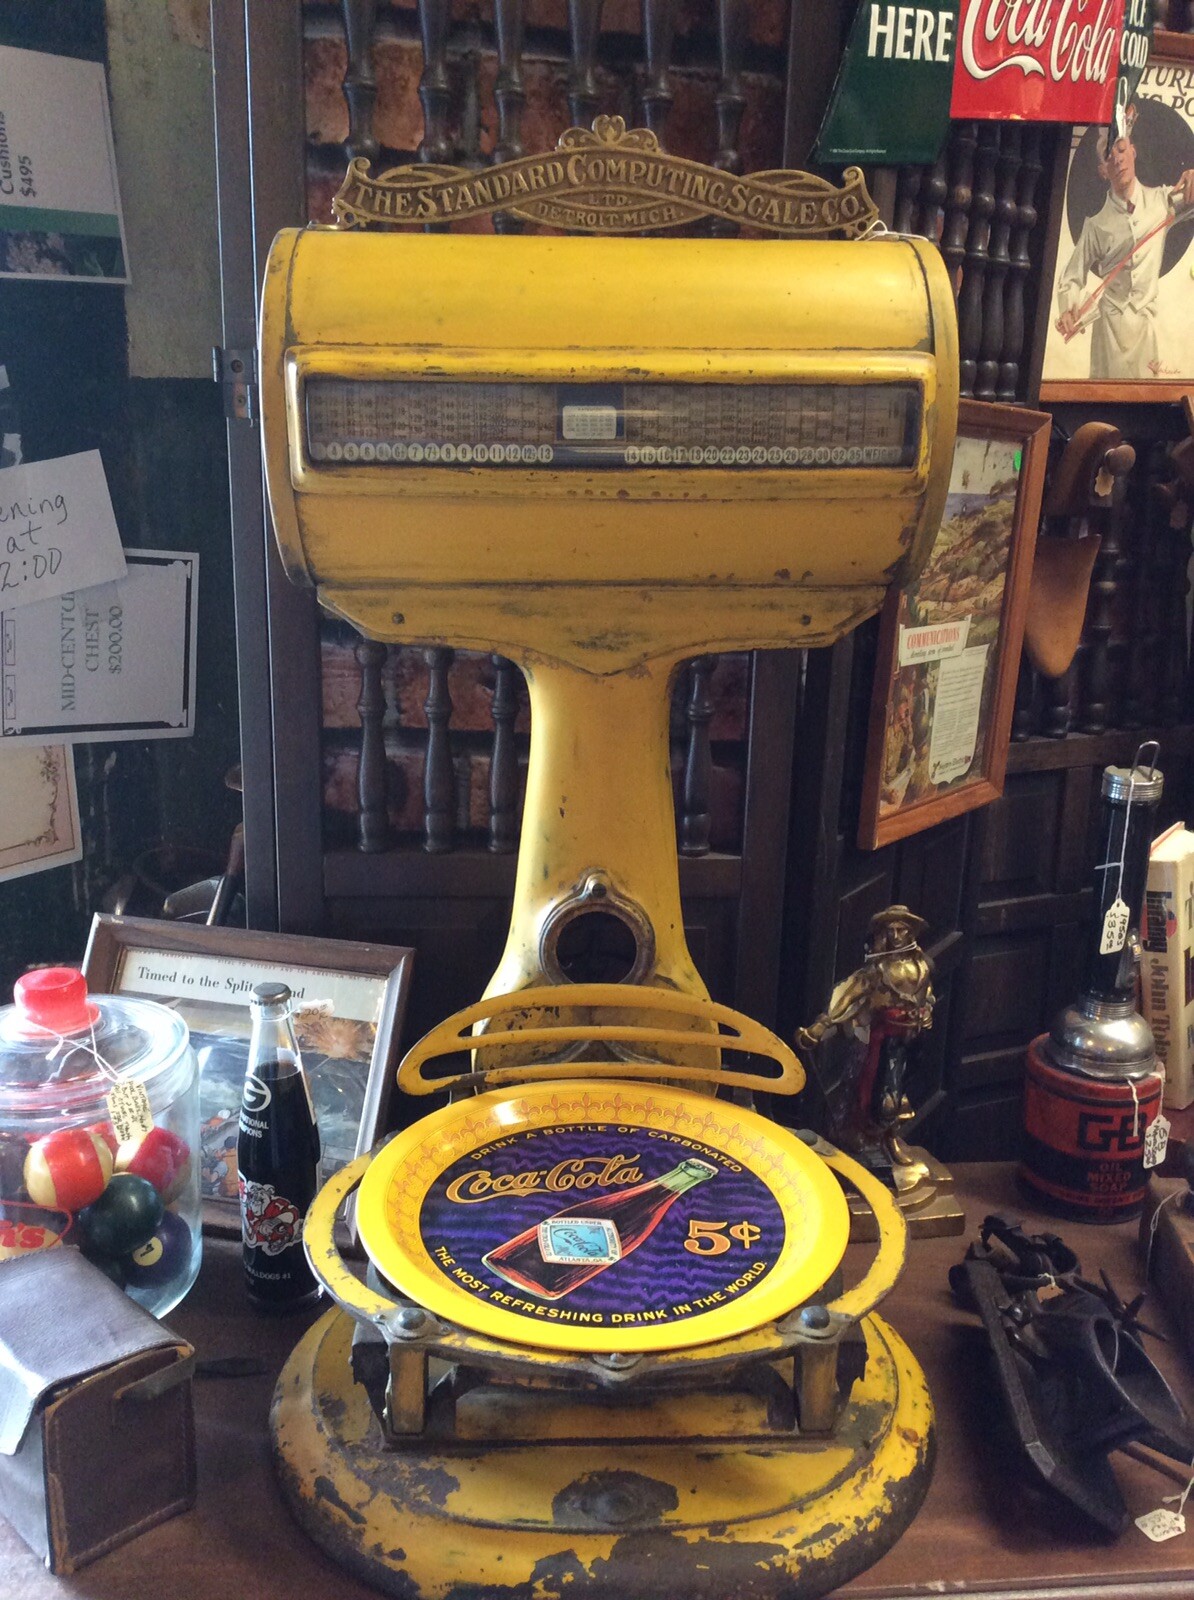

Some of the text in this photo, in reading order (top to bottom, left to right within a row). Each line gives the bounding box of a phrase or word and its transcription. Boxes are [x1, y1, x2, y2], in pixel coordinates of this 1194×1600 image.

[867, 3, 954, 62] HERE
[1129, 0, 1146, 28] ICE
[1120, 29, 1148, 69] COLD
[18, 155, 37, 198] $495
[353, 181, 412, 217] THE
[415, 160, 565, 218] STANDARD
[566, 153, 727, 207] COMPUTING
[724, 183, 818, 225] SCALE
[537, 201, 618, 226] DETROIT
[7, 520, 42, 553] at
[61, 591, 76, 711] MID-CENTU
[86, 608, 99, 672] CHEST
[108, 605, 123, 674] $200.00
[138, 966, 177, 983] Timed
[182, 973, 195, 985] to
[200, 975, 220, 988] the
[1149, 958, 1172, 1062] John Tola
[470, 1125, 743, 1173] DRINK A BOTTLE OF CARBONATED
[446, 1154, 644, 1204] Coca-Cola
[683, 1219, 761, 1256] 5¢
[434, 1245, 456, 1268] THE
[452, 1267, 490, 1293] MOST
[490, 1290, 604, 1323] REFRESHING
[611, 1309, 668, 1323] DRINK
[673, 1303, 692, 1316] IN
[693, 1290, 727, 1309] THE
